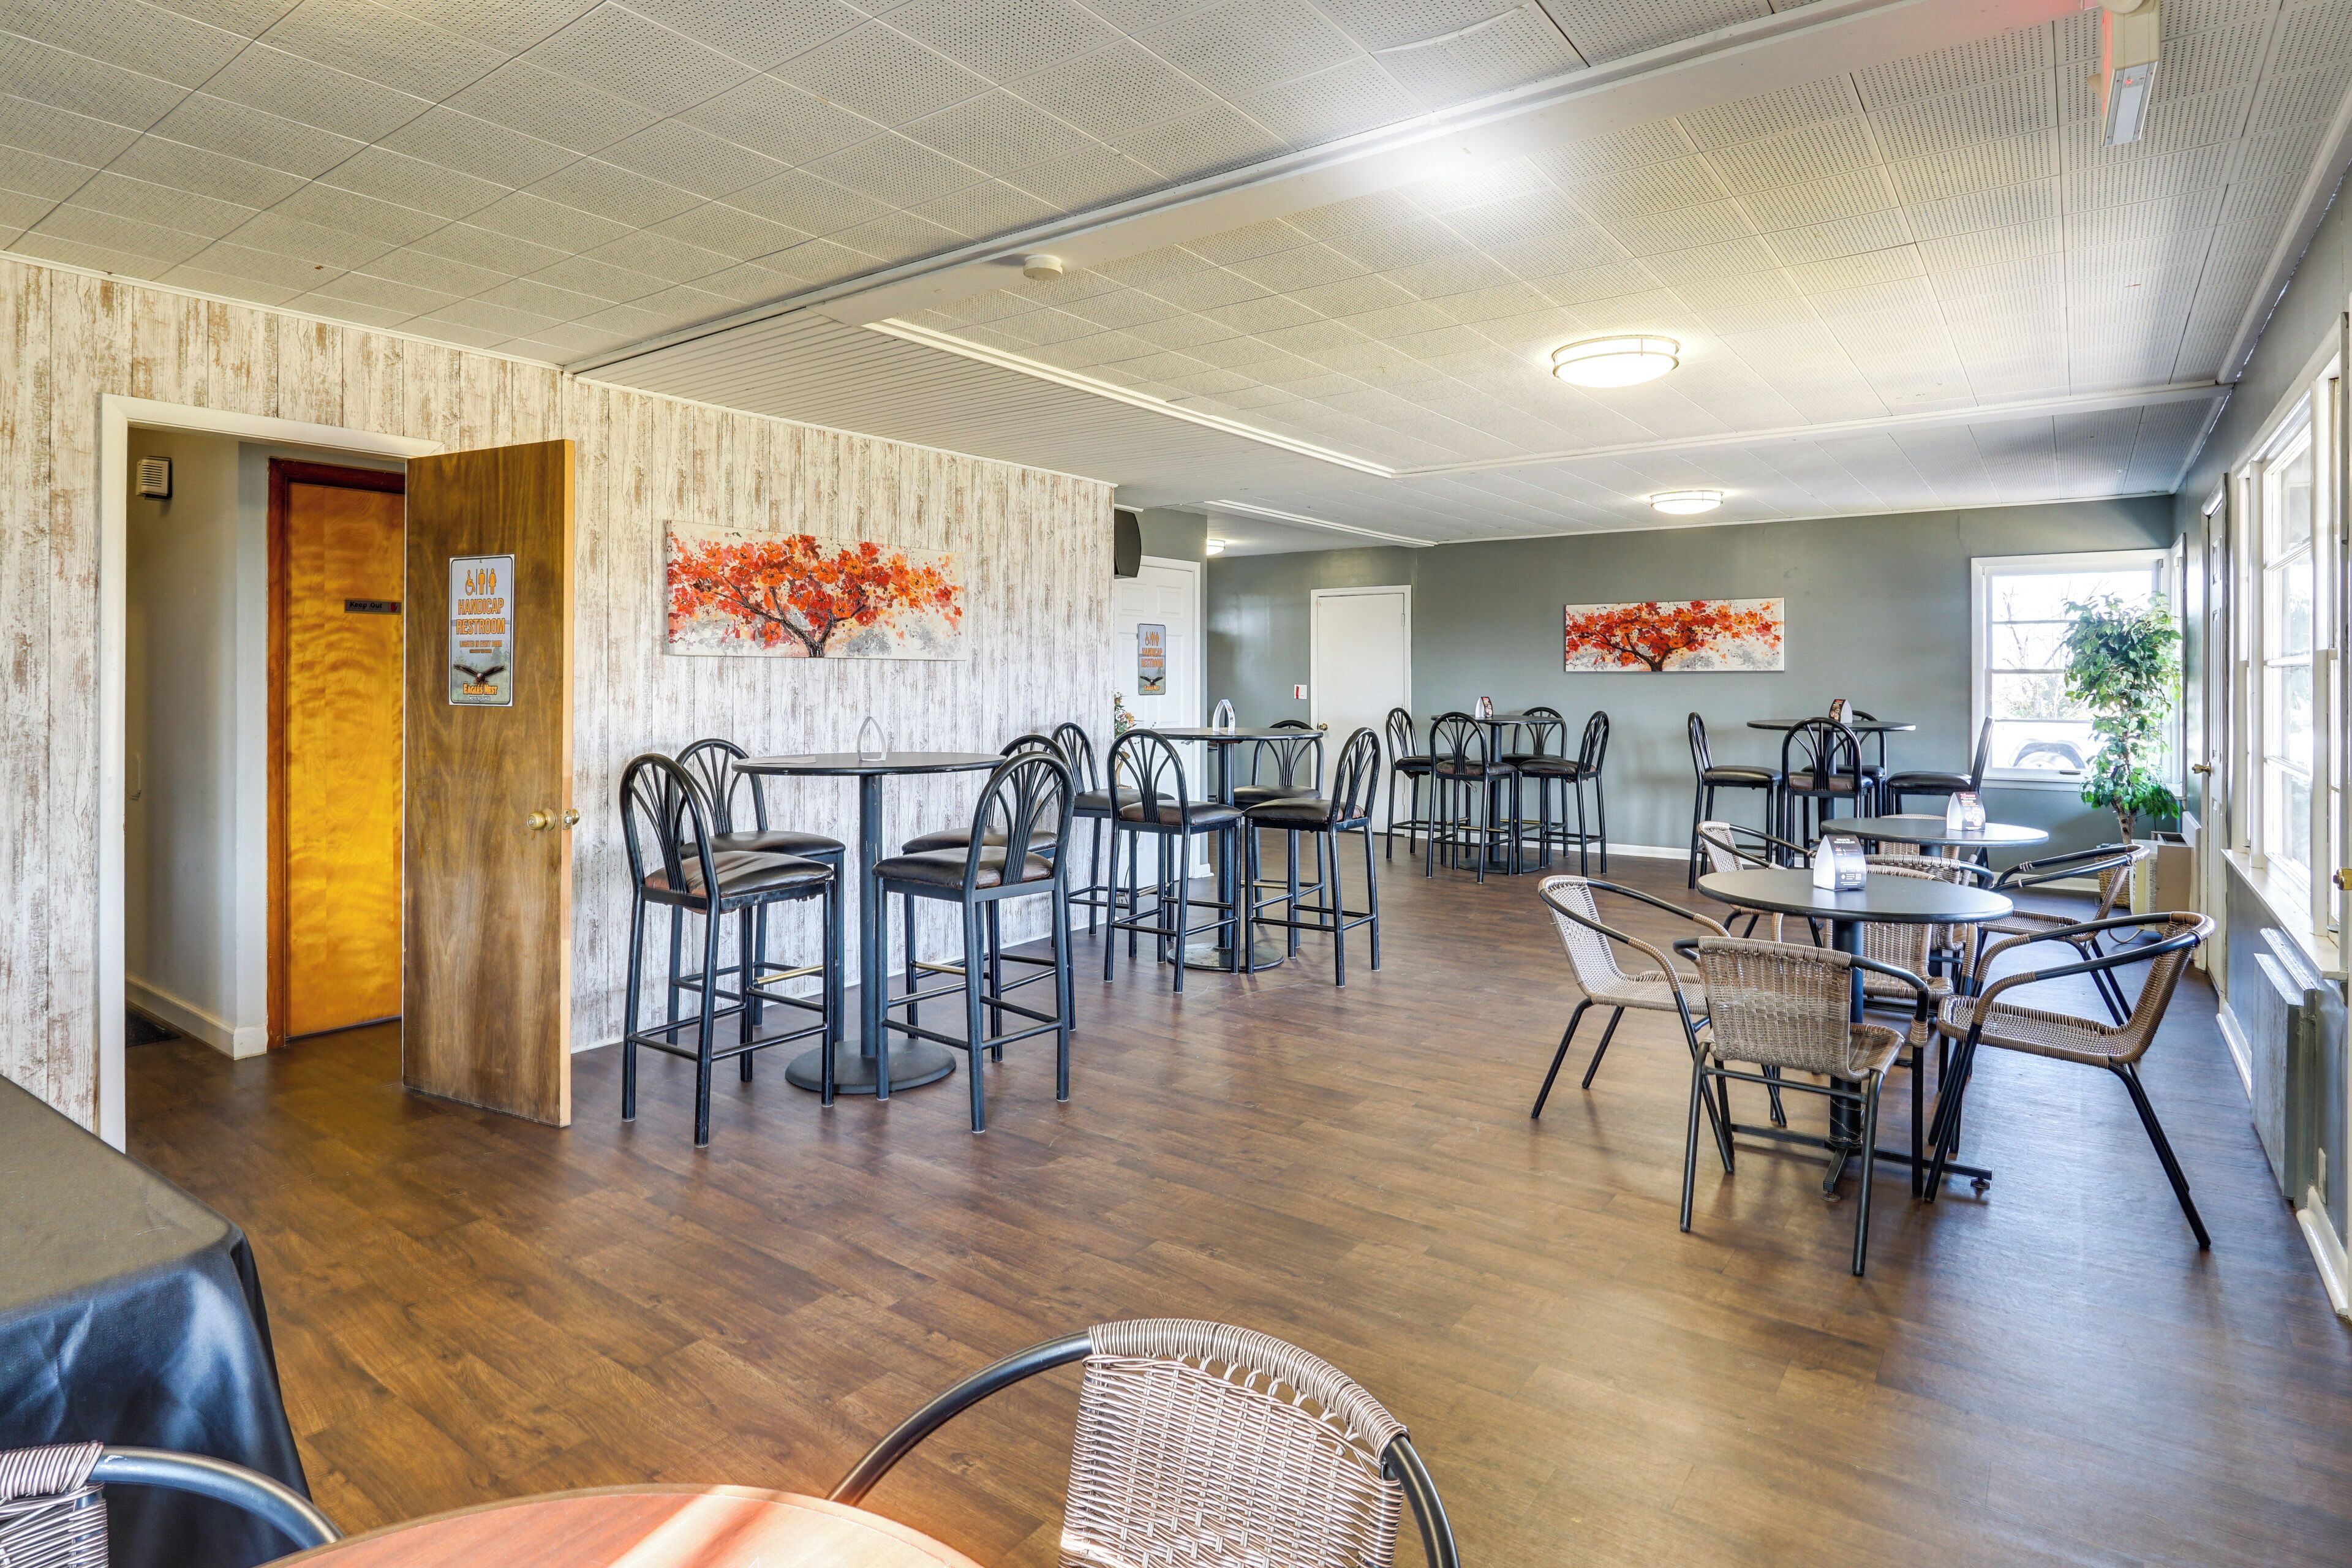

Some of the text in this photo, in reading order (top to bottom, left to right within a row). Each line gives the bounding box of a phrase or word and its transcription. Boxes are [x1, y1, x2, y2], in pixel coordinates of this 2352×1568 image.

[458, 598, 503, 615] HANDICAP
[456, 618, 505, 635] RESTROOM
[483, 682, 498, 695] NEST
